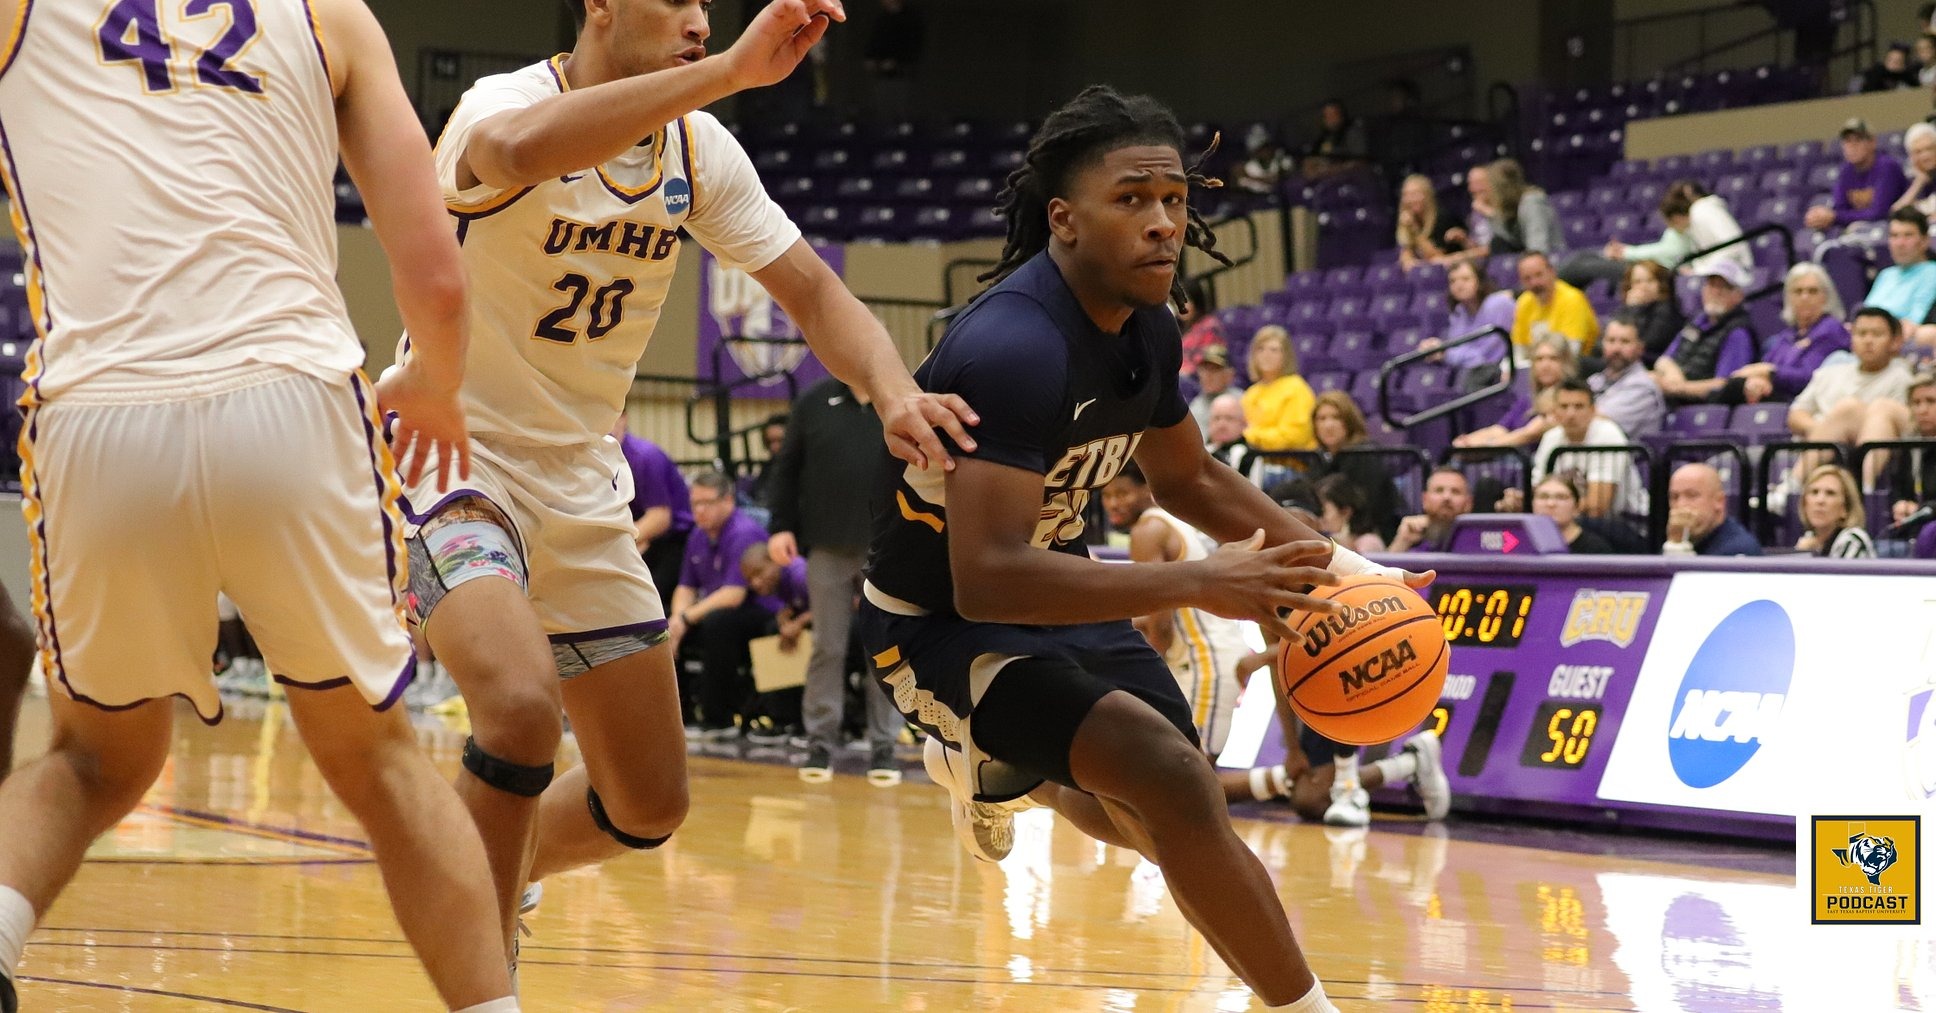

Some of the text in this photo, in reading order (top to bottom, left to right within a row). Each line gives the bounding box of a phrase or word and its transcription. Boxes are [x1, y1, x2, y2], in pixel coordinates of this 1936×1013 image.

[94, 0, 268, 98] 42
[664, 193, 690, 206] NCAA
[542, 216, 680, 262] UMHB
[532, 272, 635, 344] 20
[1303, 595, 1408, 658] Wilson
[1338, 638, 1417, 696] NCAA
[1548, 664, 1614, 700] GUEST
[1541, 709, 1597, 764] 50
